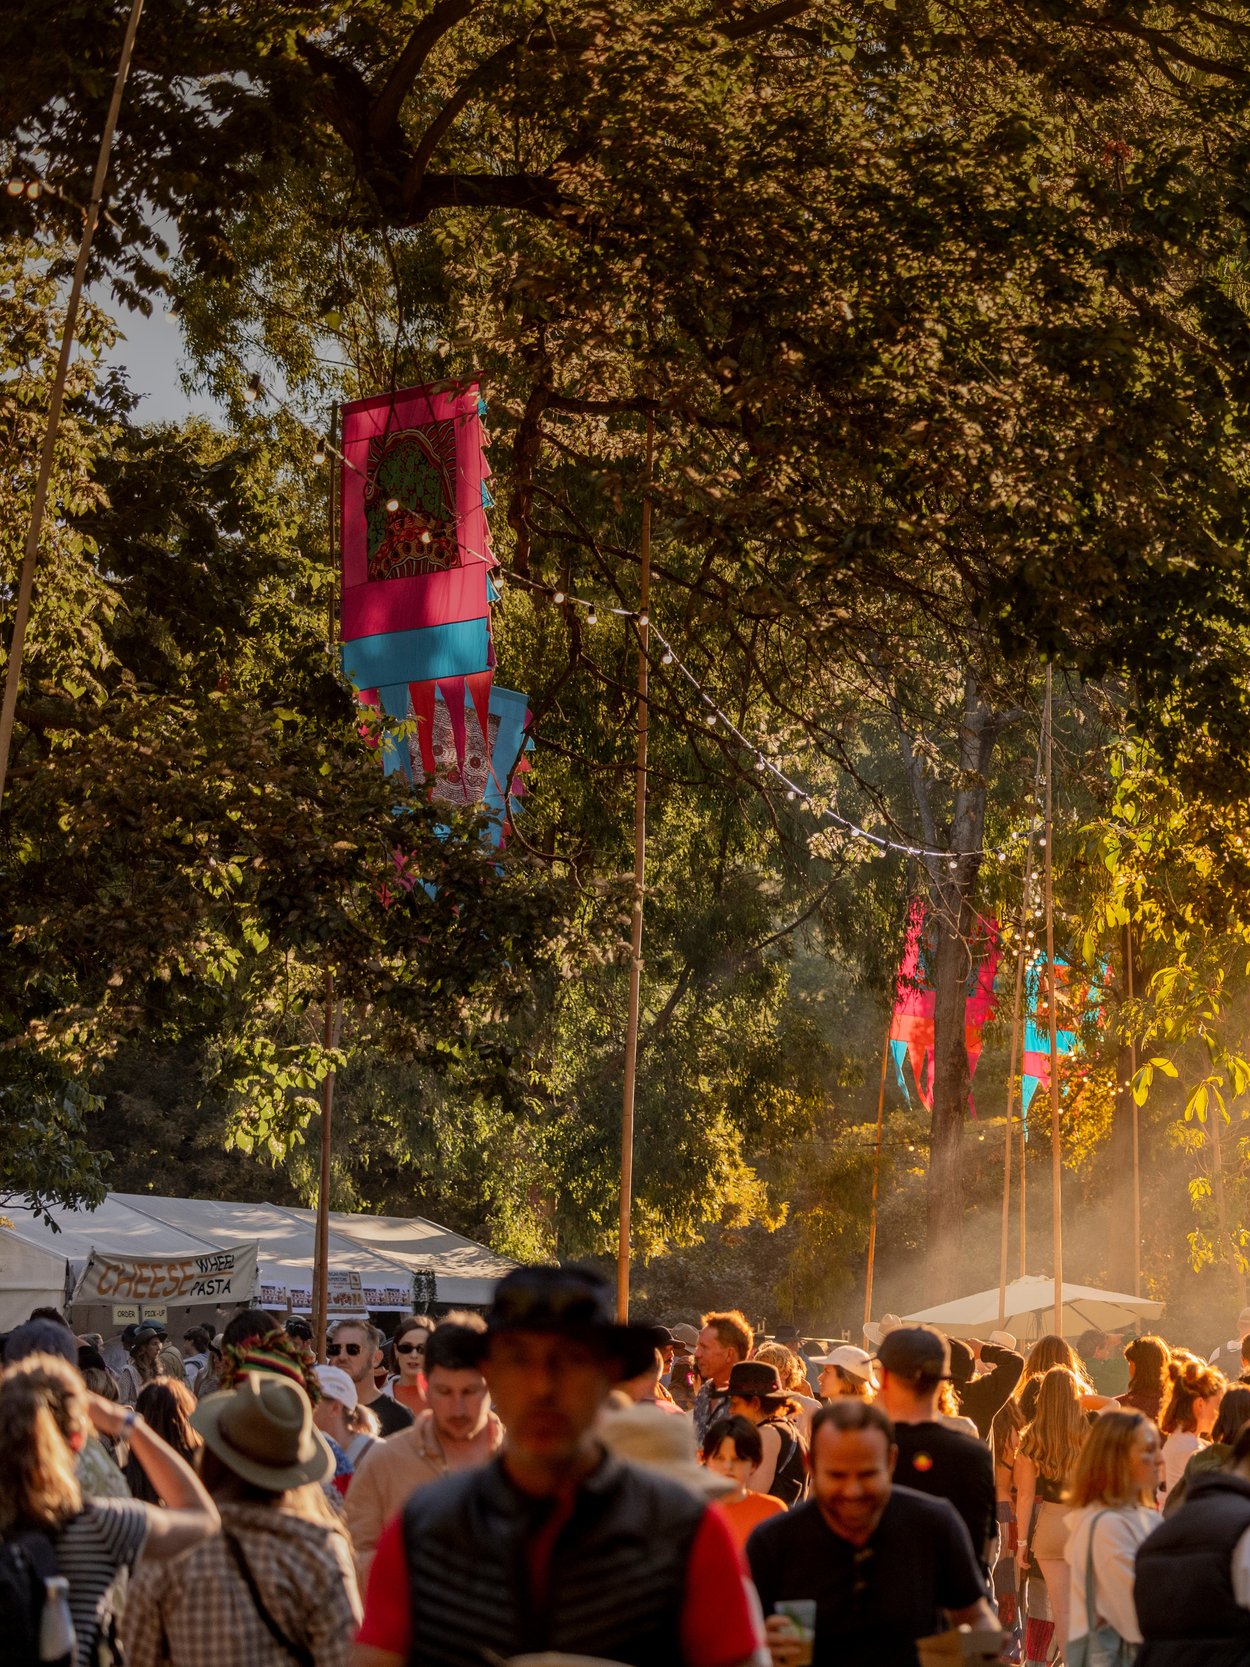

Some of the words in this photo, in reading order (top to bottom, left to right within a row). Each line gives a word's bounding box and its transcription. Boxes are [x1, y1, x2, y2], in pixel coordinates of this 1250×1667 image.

[97, 1262, 193, 1298] CHEESE
[196, 1255, 235, 1273] WHEEL
[190, 1279, 231, 1297] PASTA
[117, 1310, 136, 1318] ORDER
[144, 1309, 165, 1318] PICK-UP
